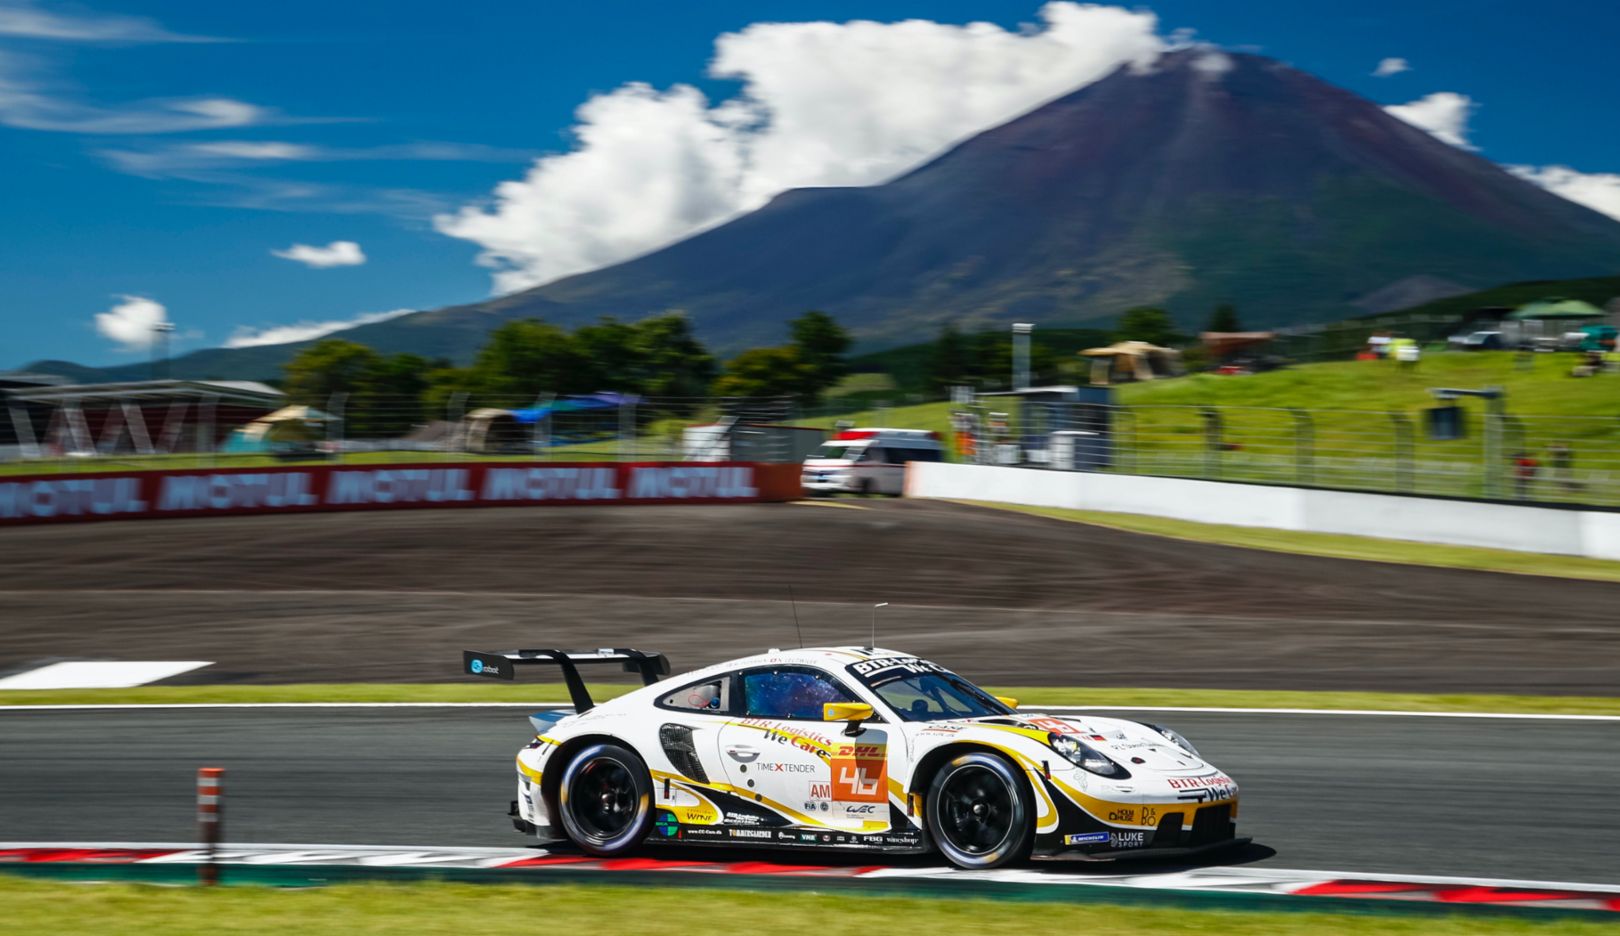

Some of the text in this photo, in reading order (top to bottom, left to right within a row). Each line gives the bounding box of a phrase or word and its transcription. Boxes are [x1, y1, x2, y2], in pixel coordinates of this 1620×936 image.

[156, 472, 317, 511] MOTUL
[325, 467, 474, 504] MOTUL
[480, 466, 622, 500] MOTUL
[627, 466, 760, 498] MOTUL
[763, 729, 831, 759] We Care
[838, 745, 880, 757] DHL
[810, 784, 831, 798] AM
[839, 766, 878, 795] 46
[846, 805, 876, 814] WEC
[1118, 832, 1144, 842] LUKE
